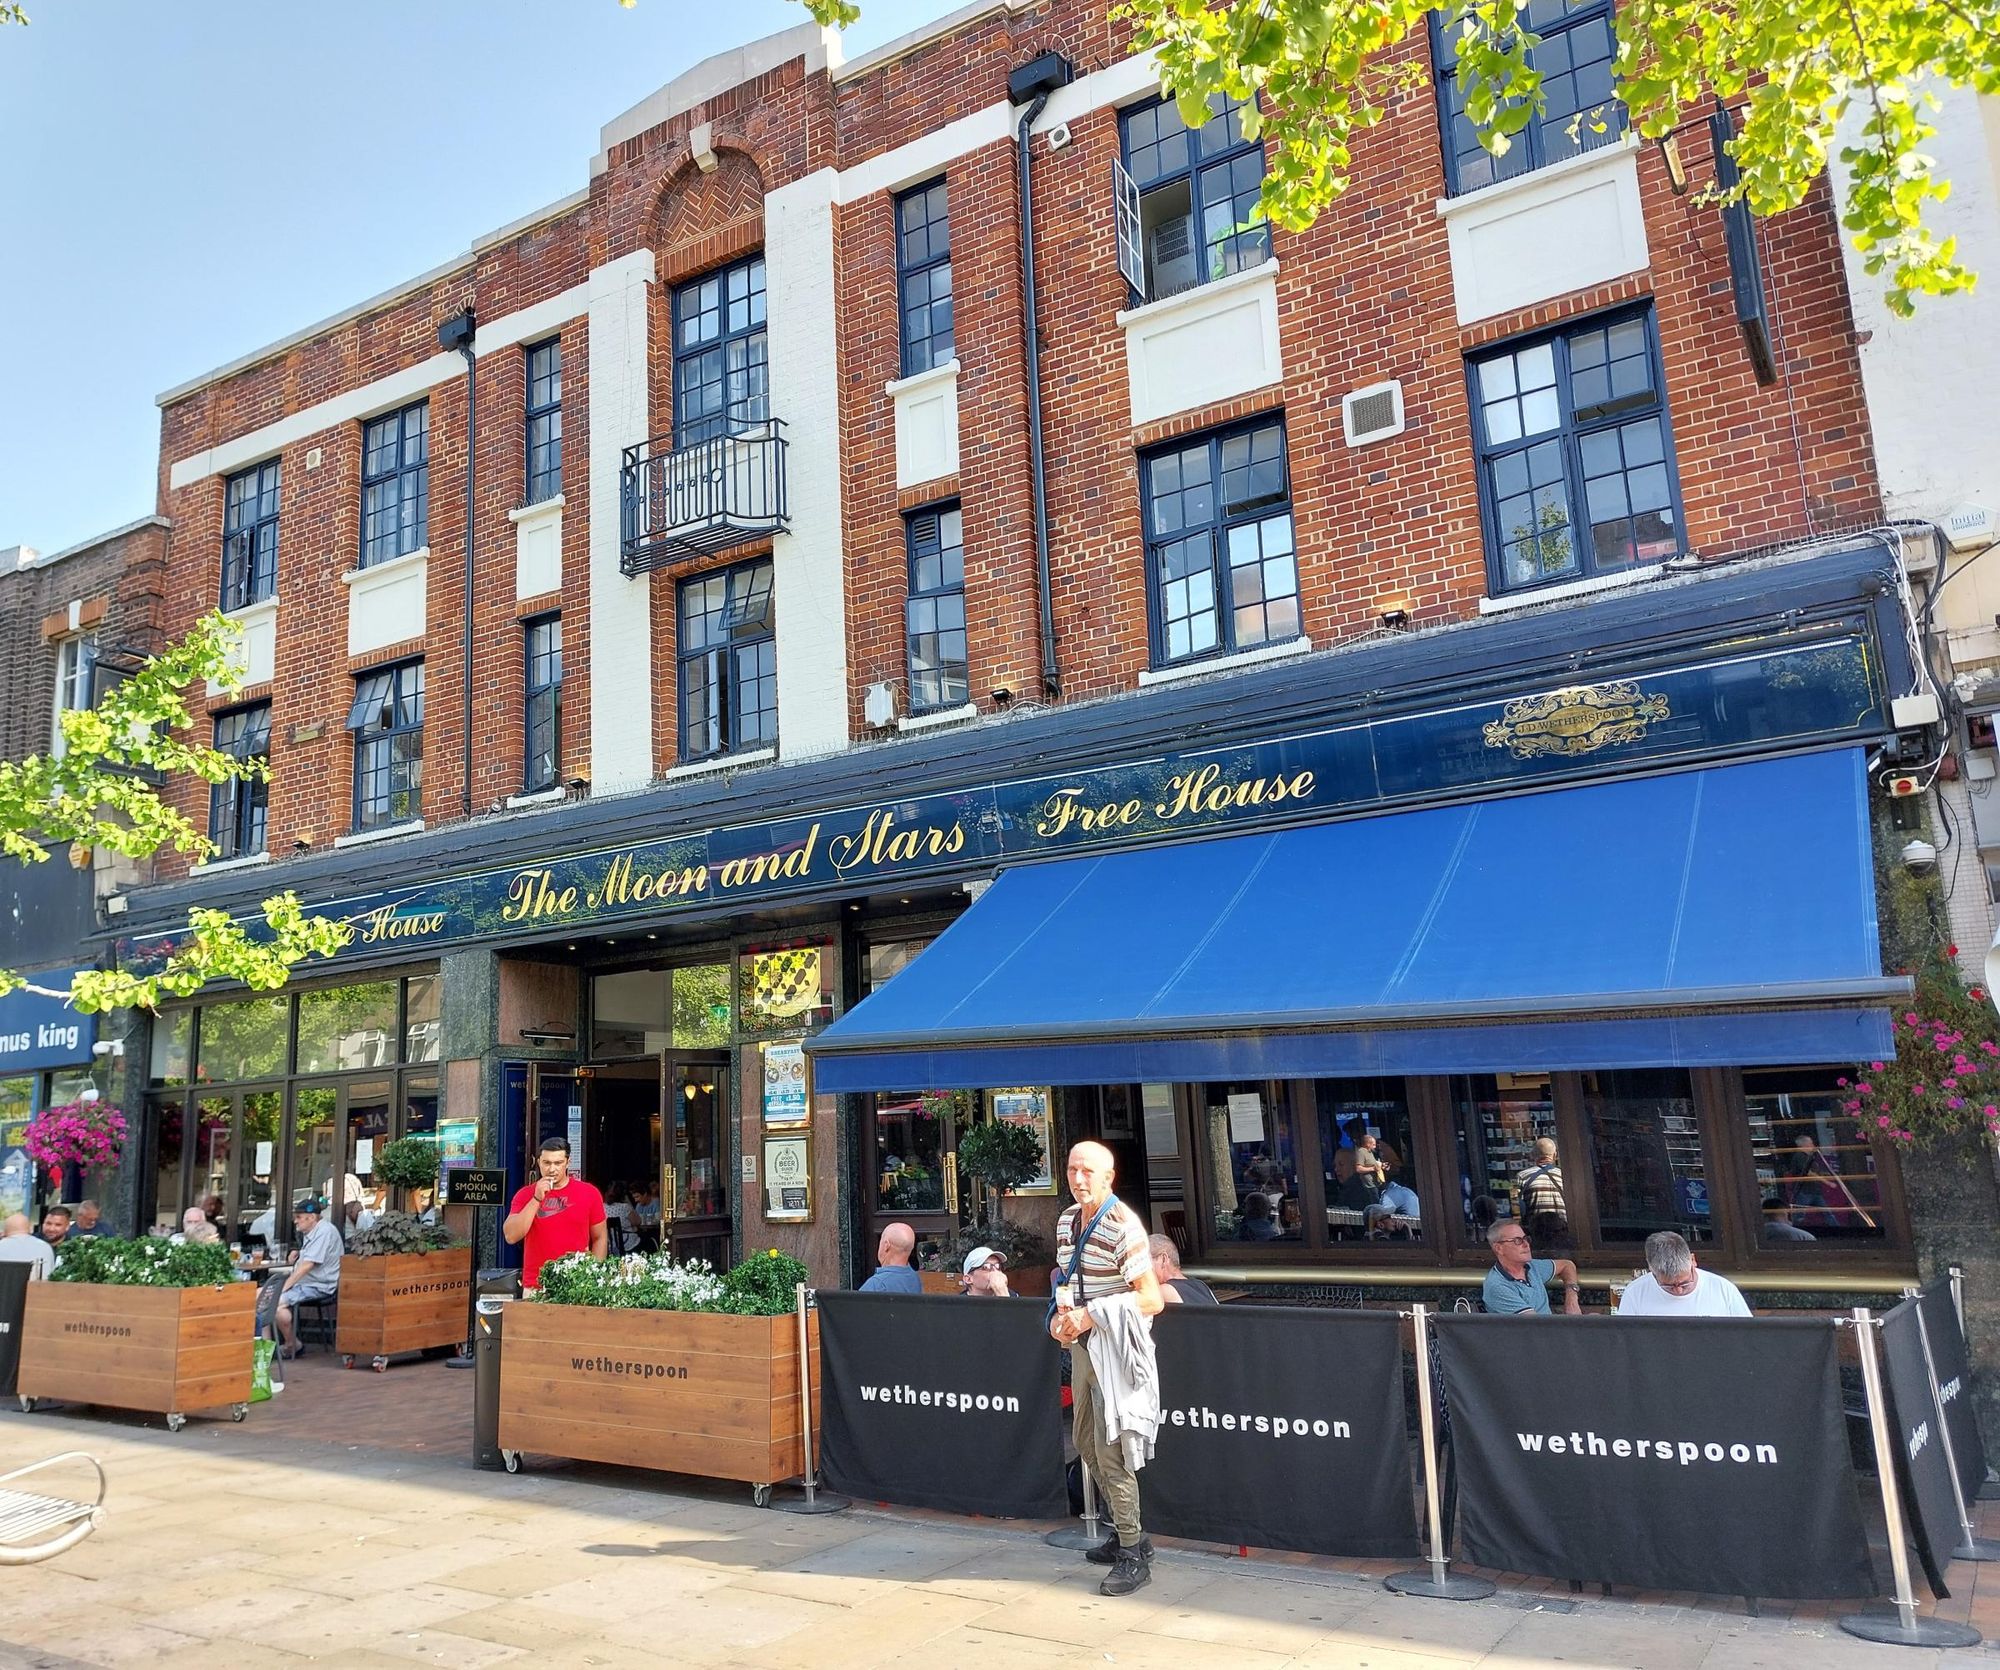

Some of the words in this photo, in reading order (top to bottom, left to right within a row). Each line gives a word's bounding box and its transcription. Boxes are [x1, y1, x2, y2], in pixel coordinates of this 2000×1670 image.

[1951, 511, 1985, 525] Initial
[1037, 787, 1143, 838] Free
[1155, 763, 1316, 819] House
[502, 868, 578, 922] The
[587, 852, 707, 909] Moon
[720, 823, 821, 888] and
[829, 808, 965, 879] Stars
[362, 904, 445, 944] House
[37, 1022, 79, 1050] king
[454, 1183, 498, 1192] SMOKING
[469, 1173, 484, 1182] NO
[463, 1193, 488, 1201] AREA
[392, 1279, 470, 1297] wetherspoon
[64, 1322, 132, 1338] wetherspoon
[571, 1355, 688, 1379] wetherspoon
[860, 1385, 1020, 1412] wetherspoon
[1516, 1431, 1778, 1466] wetherspoon
